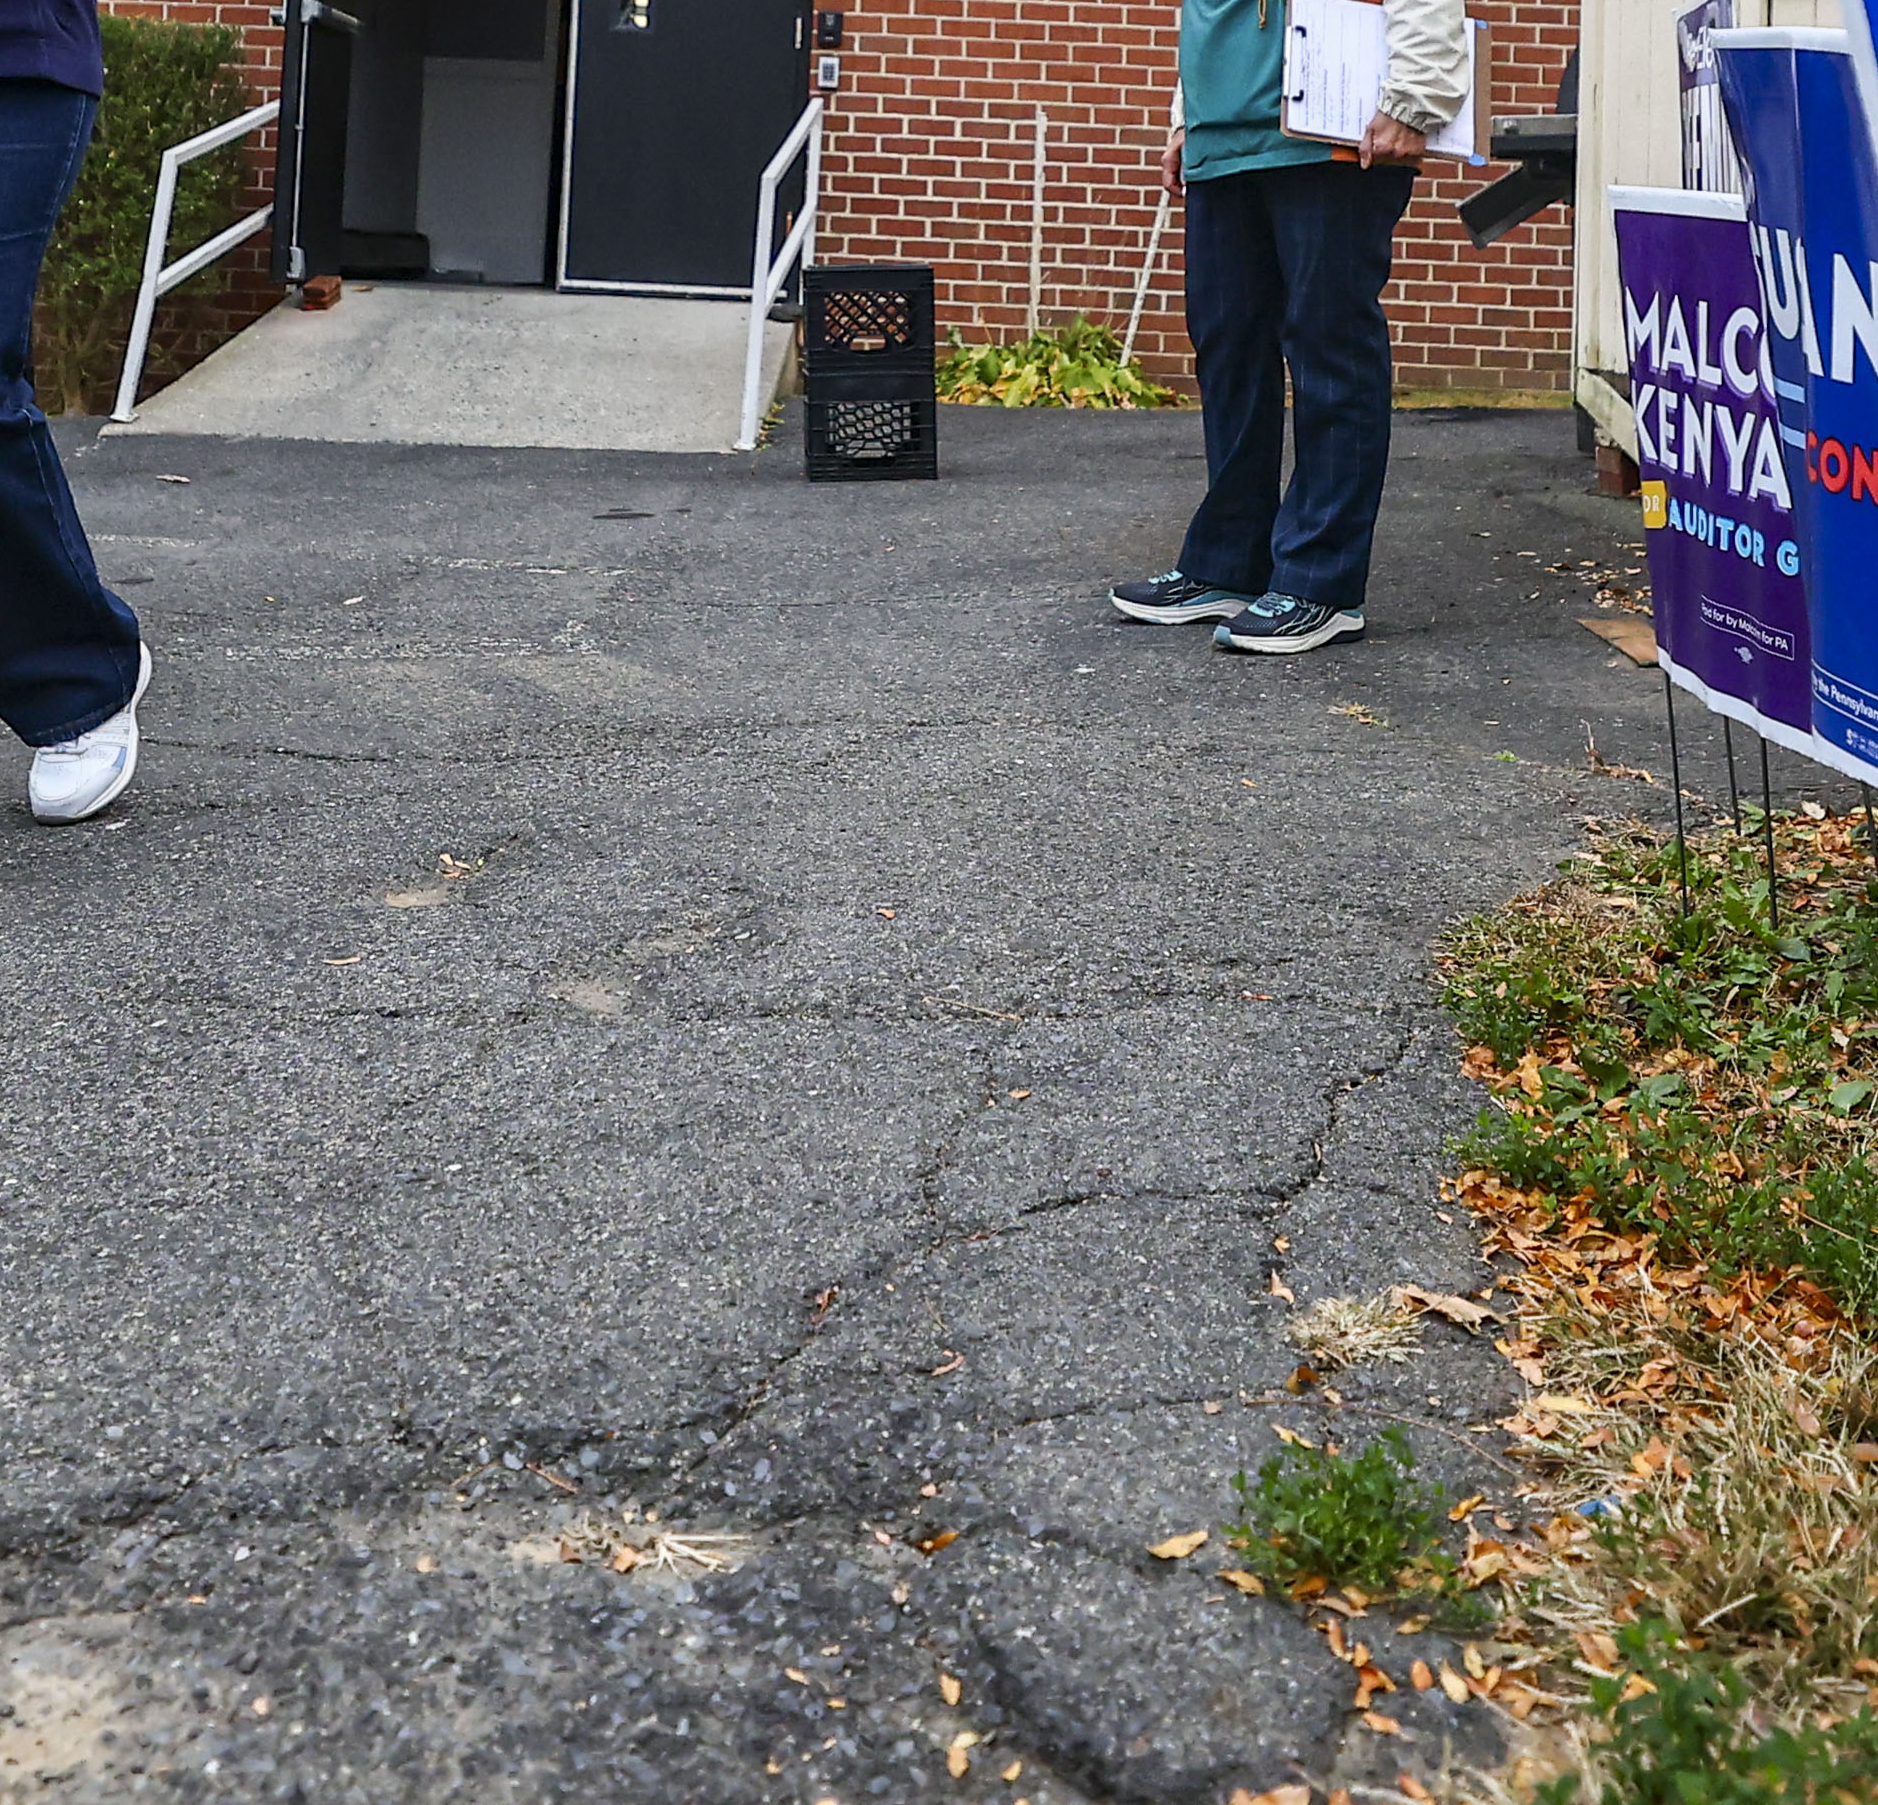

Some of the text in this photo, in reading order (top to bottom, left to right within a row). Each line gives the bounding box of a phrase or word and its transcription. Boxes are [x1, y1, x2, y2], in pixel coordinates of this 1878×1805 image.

[1626, 286, 1776, 401] MALC
[1631, 379, 1792, 511] KENYA
[1668, 496, 1765, 568] AUDITOR
[1713, 608, 1725, 623] for
[1726, 613, 1739, 629] by
[1762, 630, 1774, 647] for
[1775, 636, 1789, 652] PA
